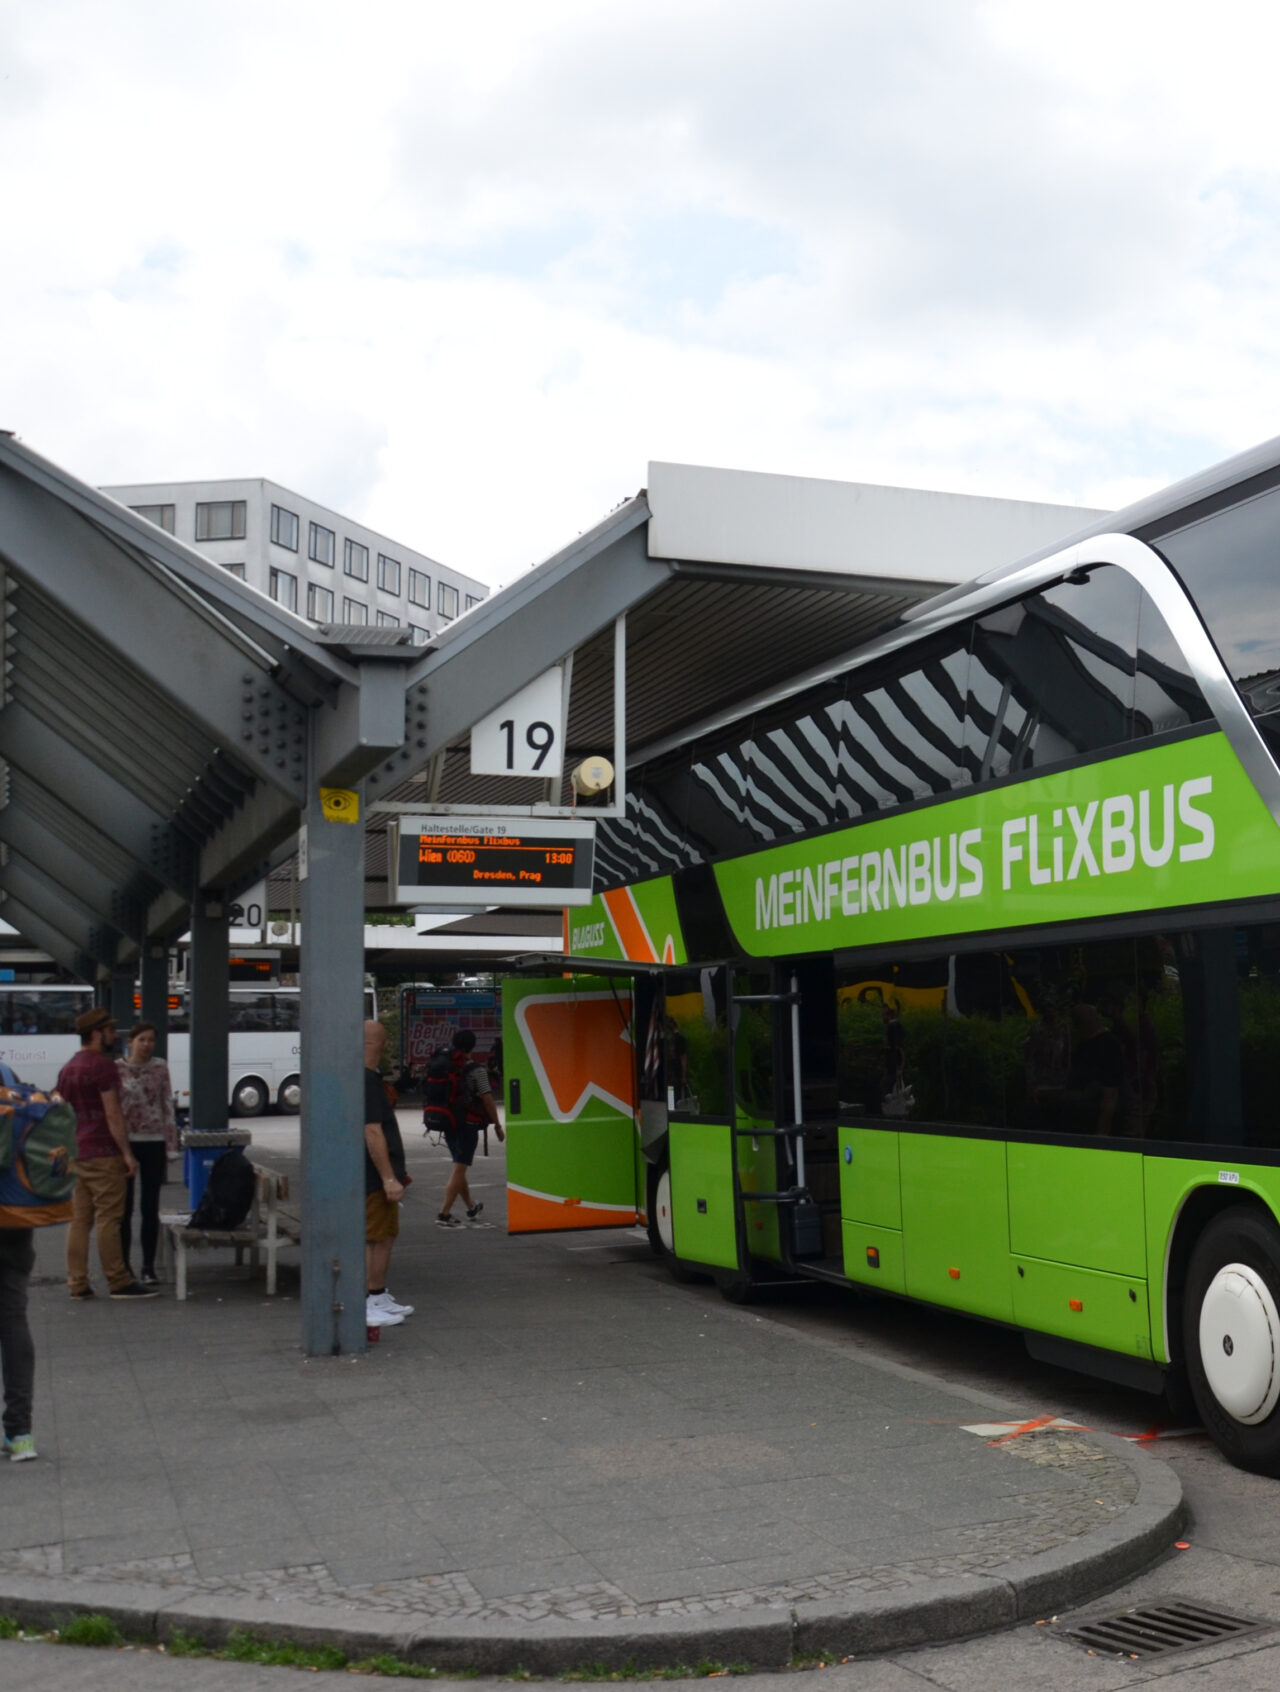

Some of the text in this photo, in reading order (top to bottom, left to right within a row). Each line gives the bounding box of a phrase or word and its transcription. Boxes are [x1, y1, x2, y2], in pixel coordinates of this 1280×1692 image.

[499, 719, 555, 770] 19
[421, 823, 507, 835] Haltestelle/Gate 19
[418, 849, 573, 865] Wien (060) 13:00
[473, 869, 542, 883] Dresden, Prag
[229, 904, 262, 928] 20
[572, 921, 606, 950] BLAGUSS
[413, 1023, 457, 1040] Berlin
